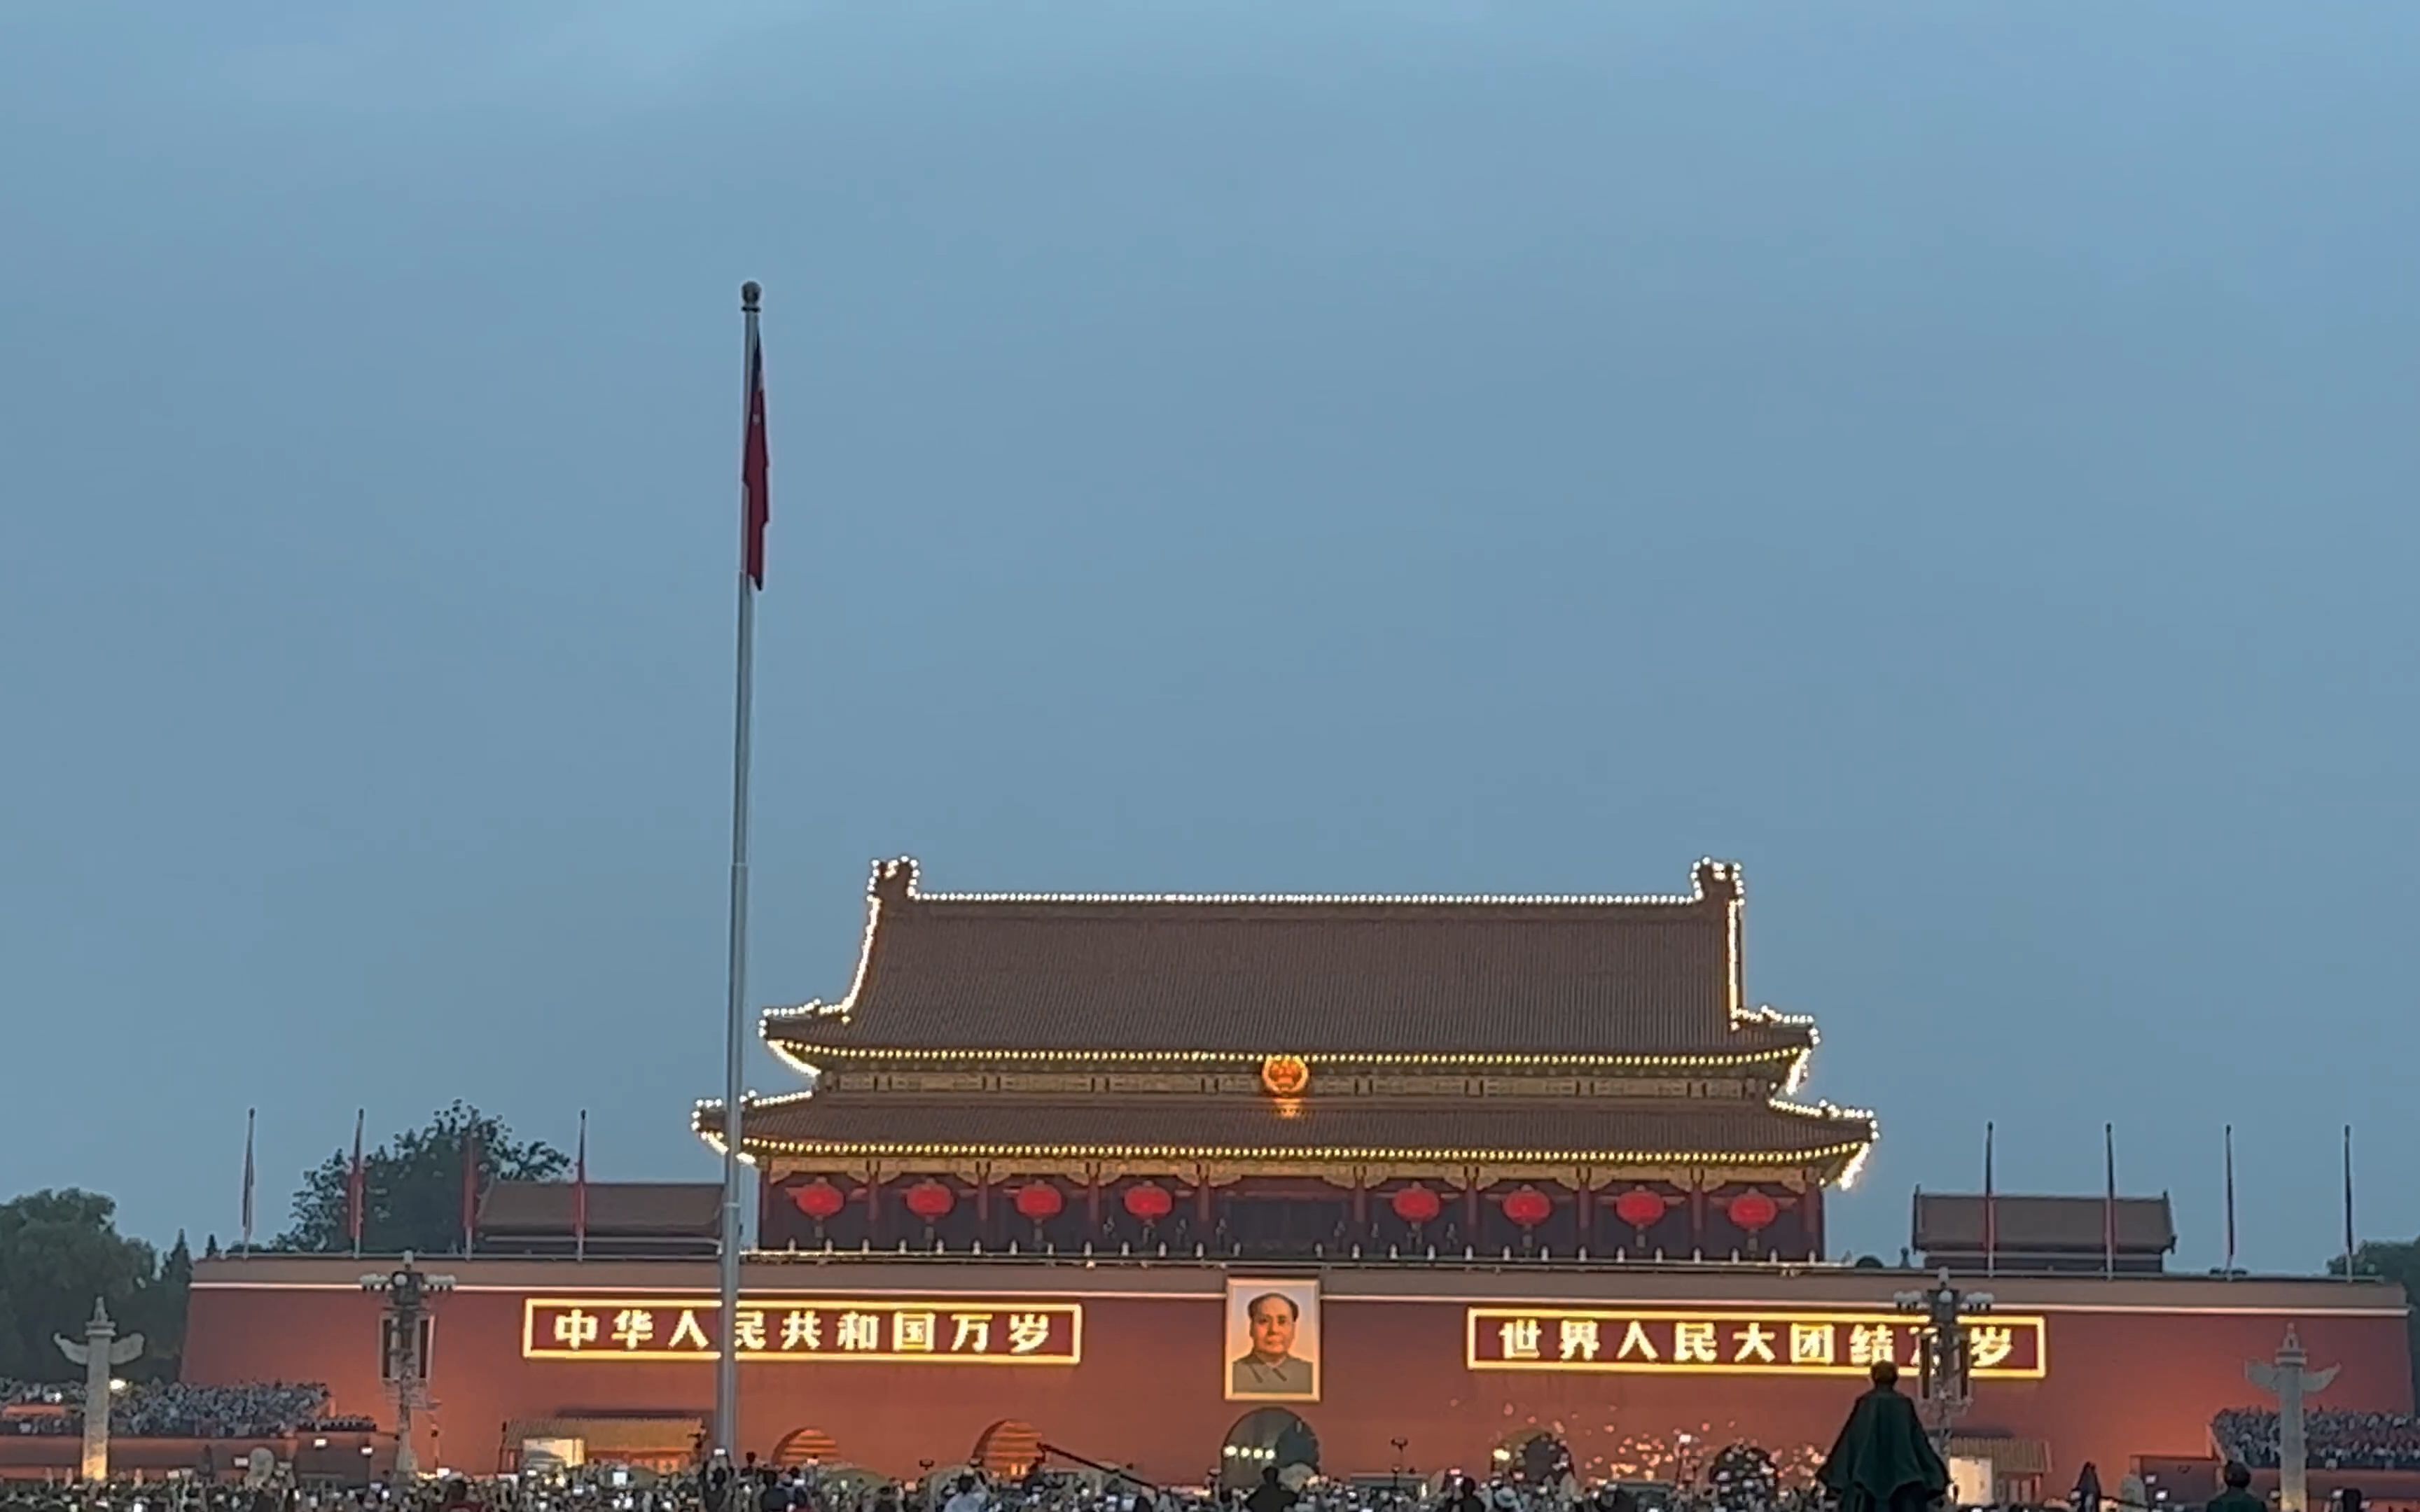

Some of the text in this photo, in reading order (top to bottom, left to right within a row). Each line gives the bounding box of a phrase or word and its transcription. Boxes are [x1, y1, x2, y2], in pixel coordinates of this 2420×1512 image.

[554, 1308, 1050, 1353] 中华人民共和国万岁
